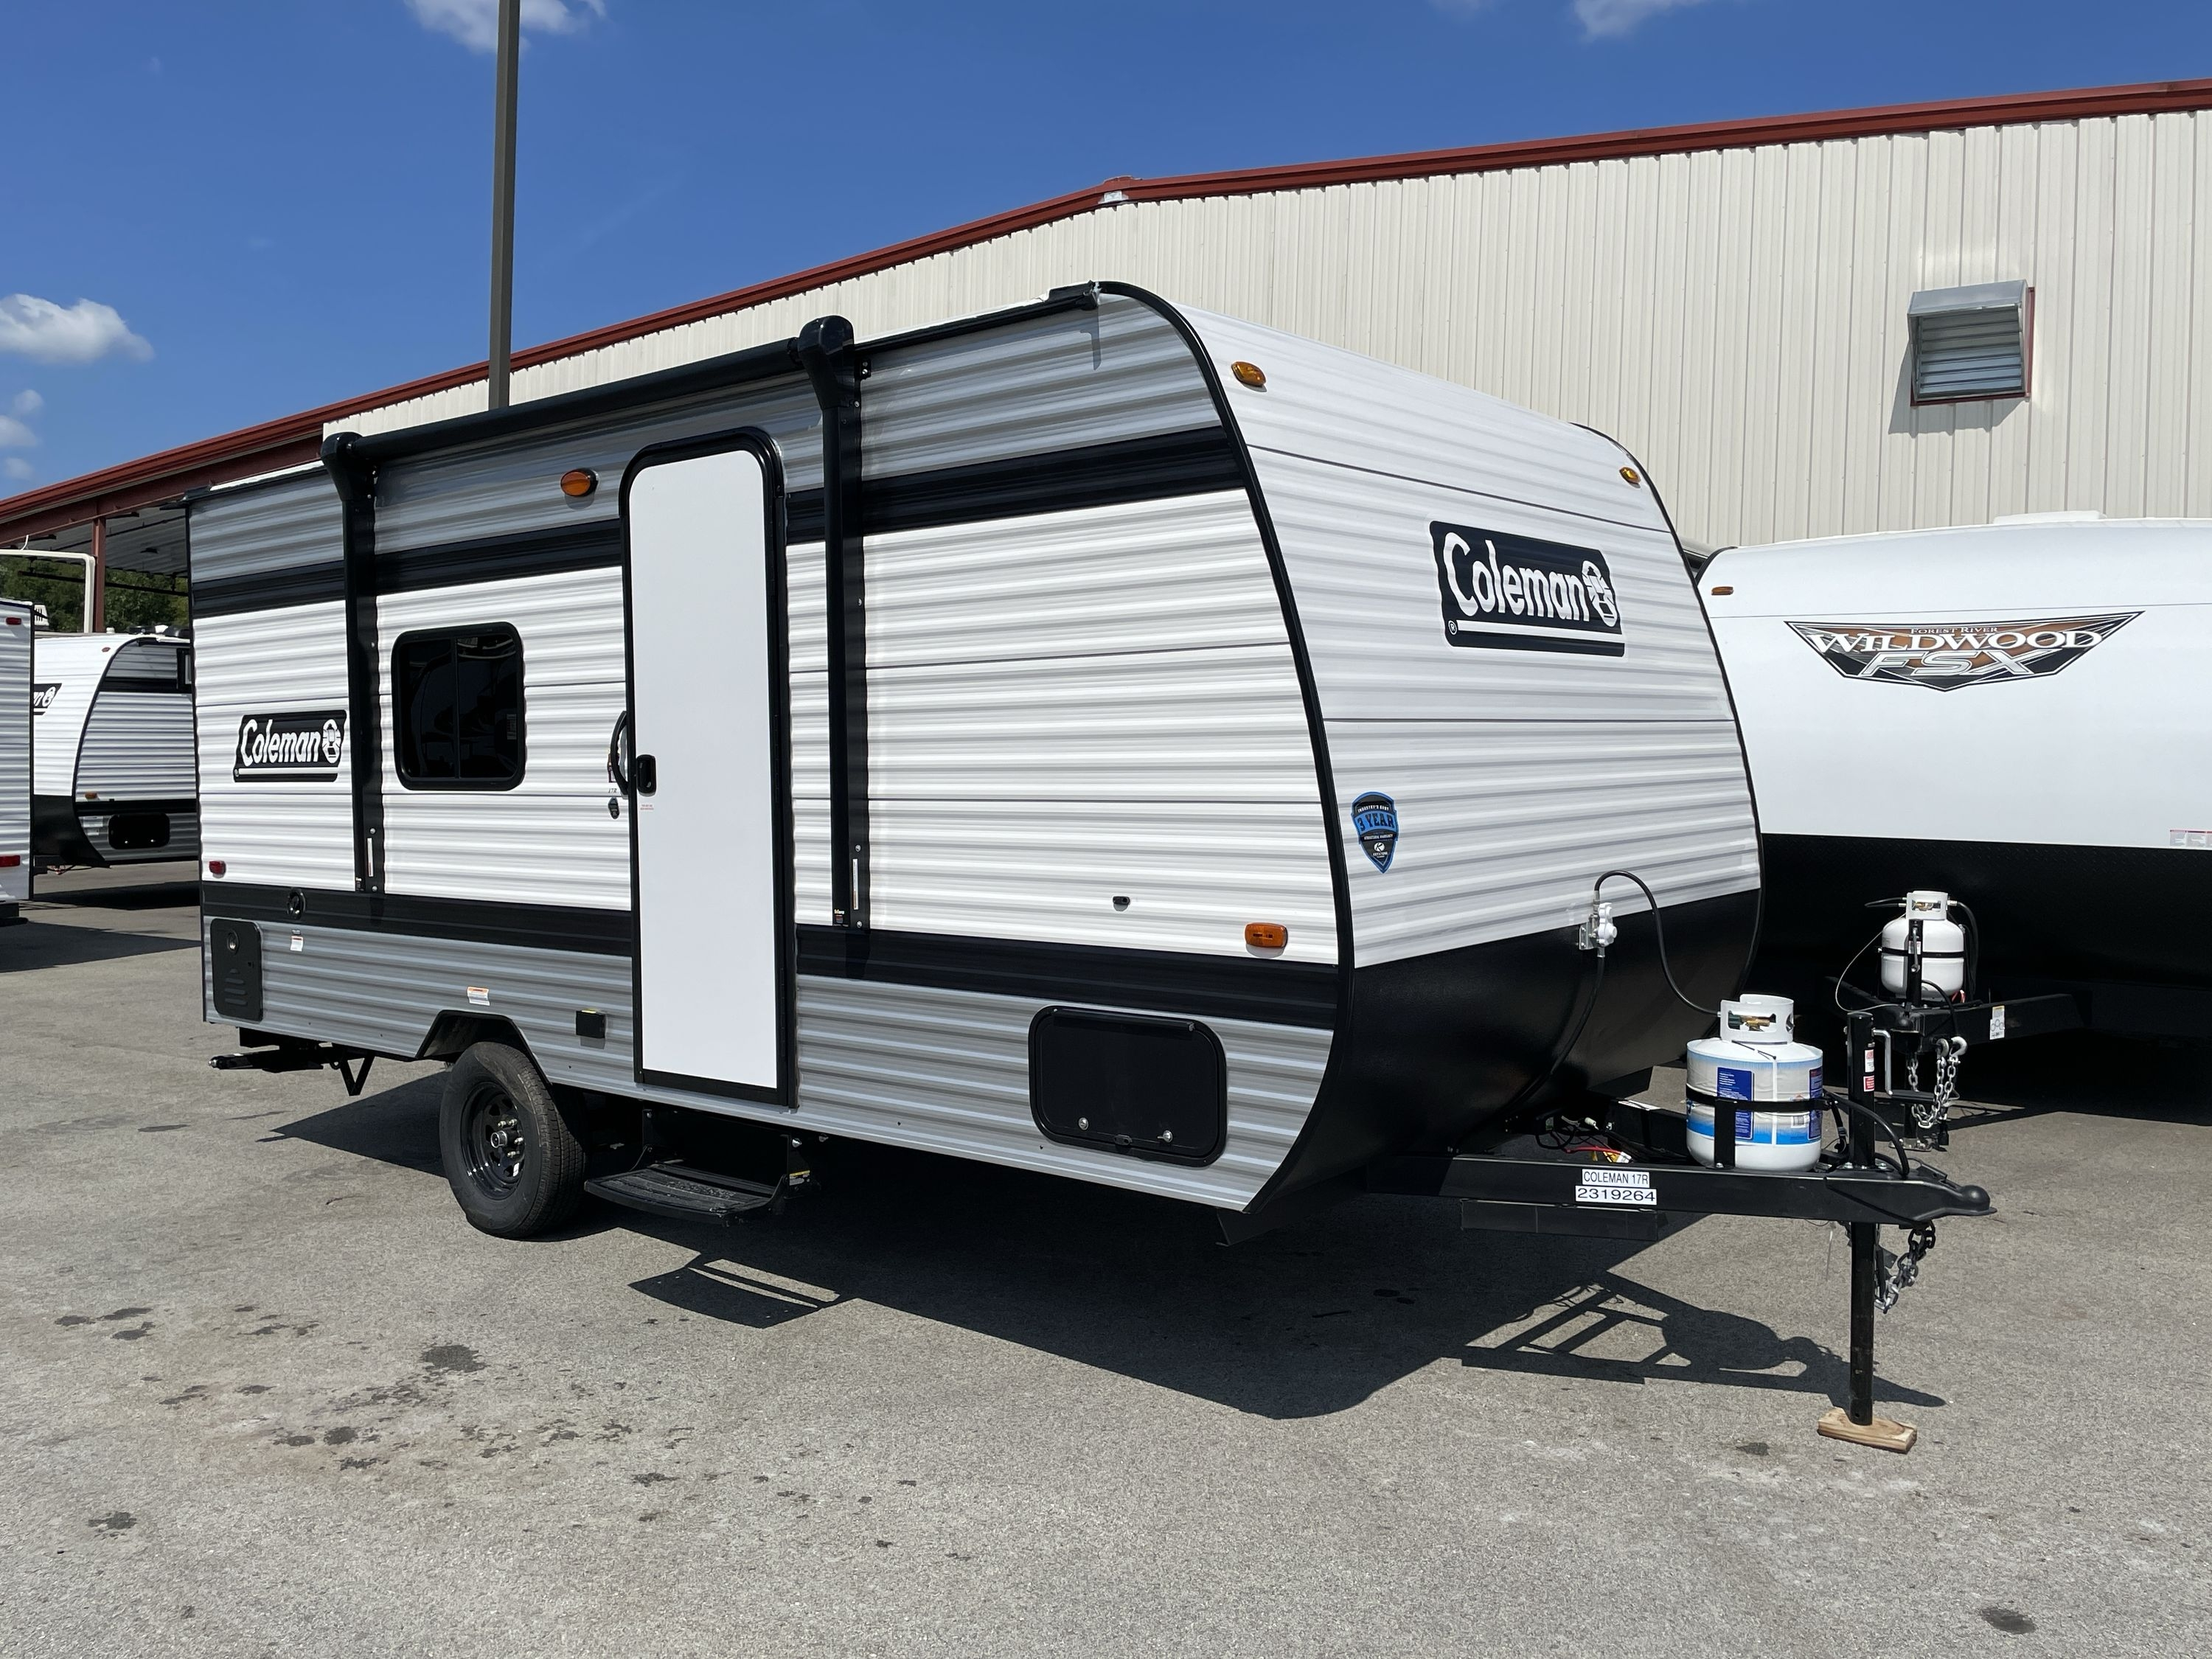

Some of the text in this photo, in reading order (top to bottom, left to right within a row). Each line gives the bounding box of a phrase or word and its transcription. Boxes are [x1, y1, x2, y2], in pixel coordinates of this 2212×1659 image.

[1443, 532, 1590, 622] Coleman
[1806, 630, 2103, 653] WILDWOOD
[1860, 648, 2063, 676] FSX
[240, 719, 321, 767] Coleman
[1357, 813, 1395, 832] 3 YEAR
[1583, 1171, 1649, 1185] COLEMAN 17R
[1577, 1187, 1655, 1202] 2319264
